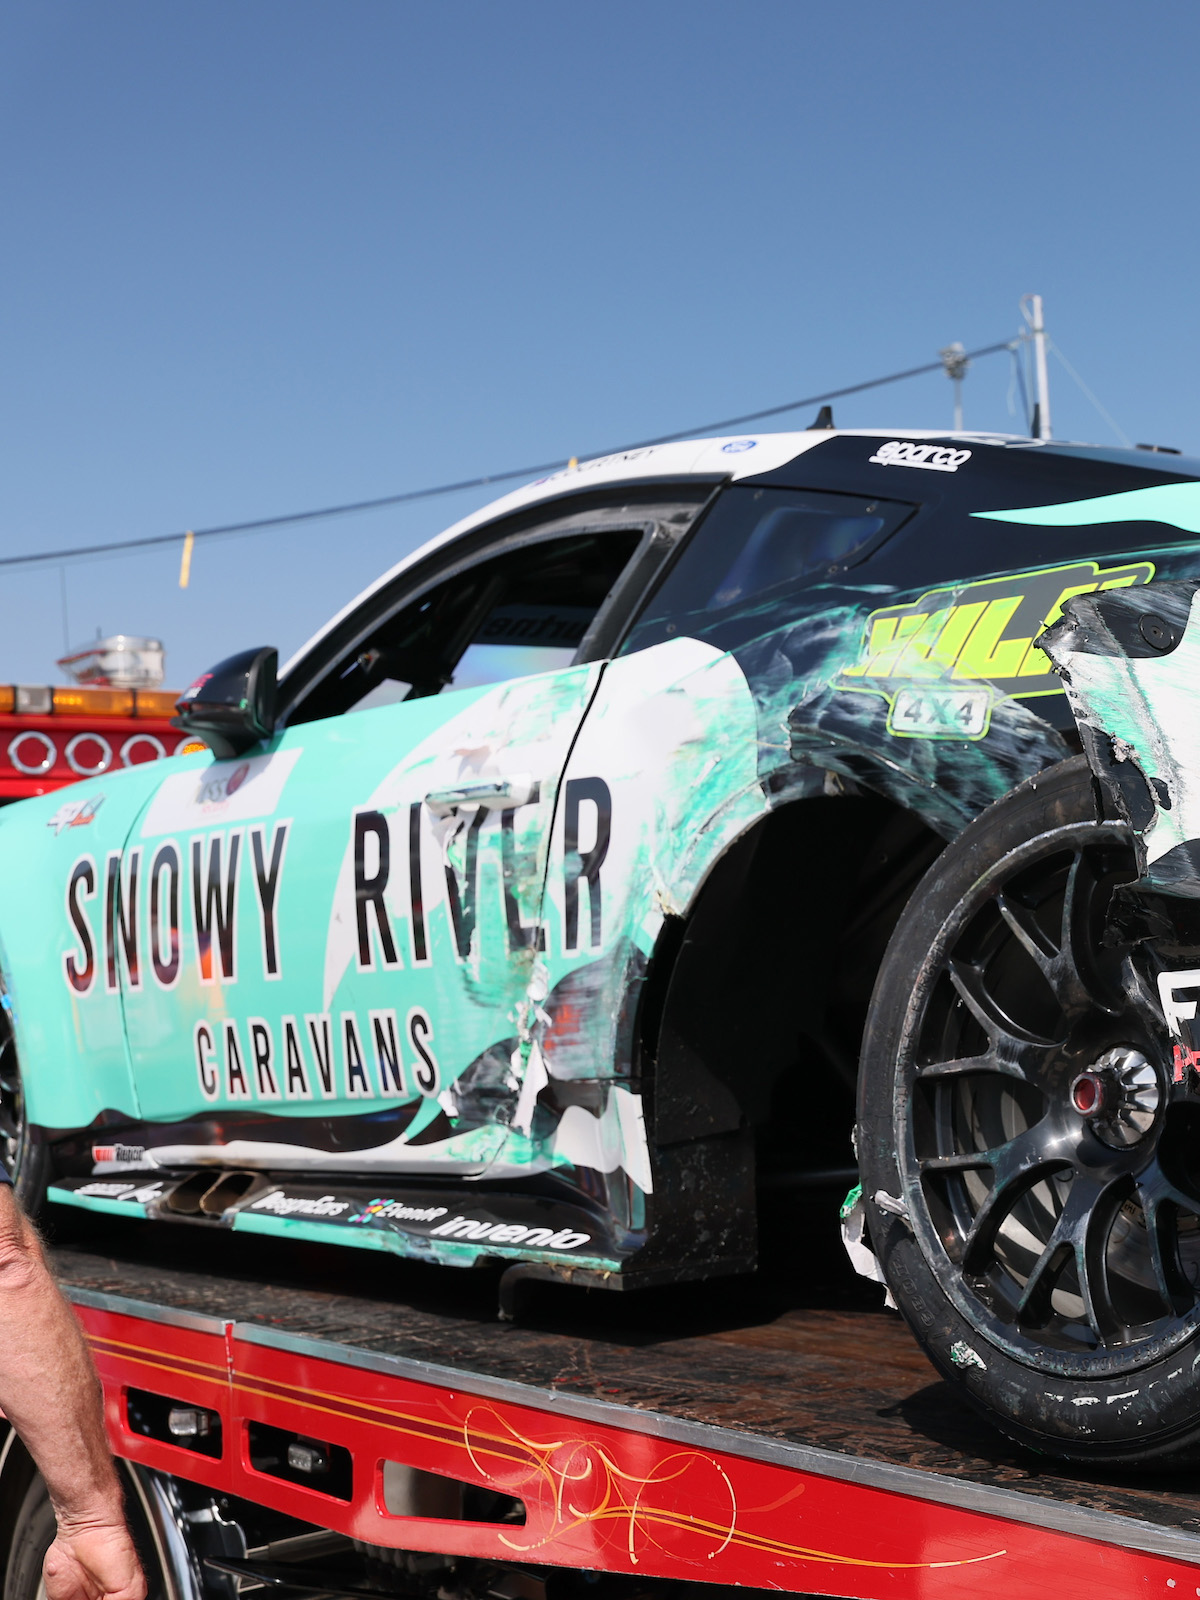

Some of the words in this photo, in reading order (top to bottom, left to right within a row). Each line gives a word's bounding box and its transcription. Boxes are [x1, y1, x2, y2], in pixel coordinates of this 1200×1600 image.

[869, 441, 972, 471] sparco
[64, 822, 290, 995] SNOWY
[196, 1012, 436, 1096] CARAVANS
[430, 1215, 592, 1250] invenio
